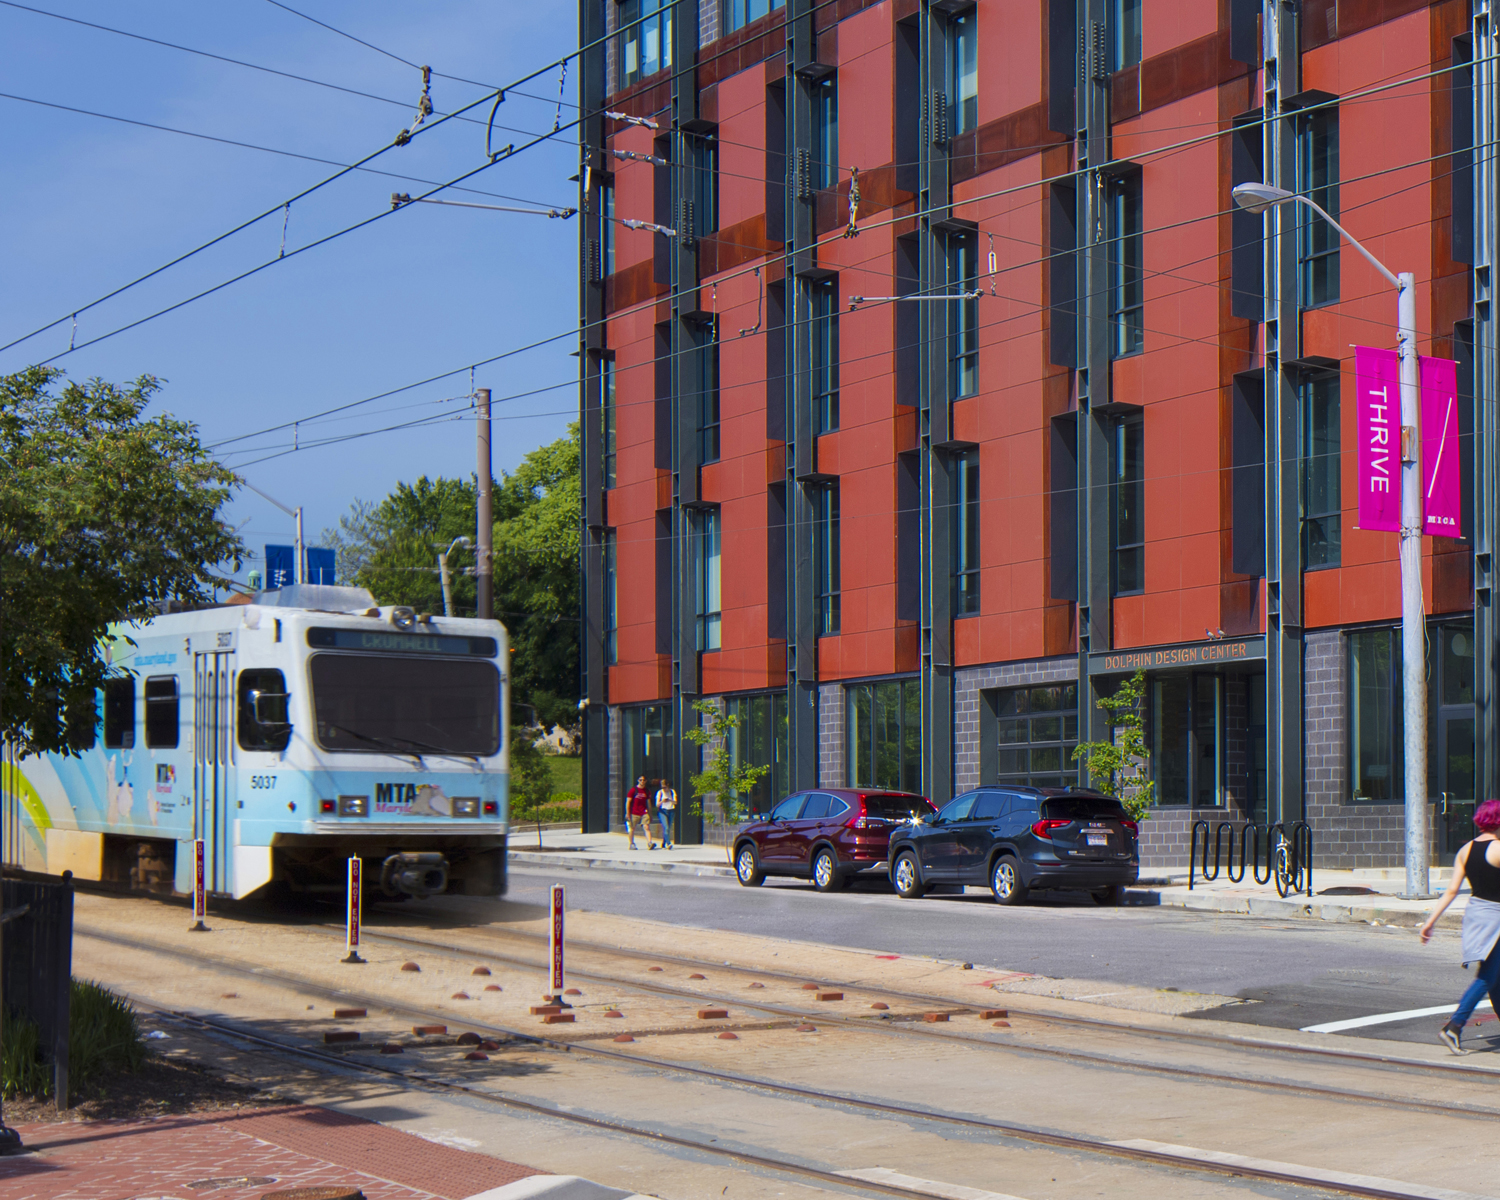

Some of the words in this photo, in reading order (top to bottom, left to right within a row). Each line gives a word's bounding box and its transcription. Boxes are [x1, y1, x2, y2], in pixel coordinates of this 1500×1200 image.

[1369, 386, 1389, 493] THRIVE
[1427, 515, 1456, 525] MICA
[361, 633, 441, 651] CROMWELL
[1105, 653, 1151, 669] DOLPHIN
[1155, 649, 1197, 664] DESIGN
[1201, 643, 1246, 660] CENTER
[251, 775, 277, 789] 5037
[375, 783, 416, 803] MTA
[198, 843, 203, 855] DO
[353, 862, 358, 876] DO
[556, 890, 562, 908] DO
